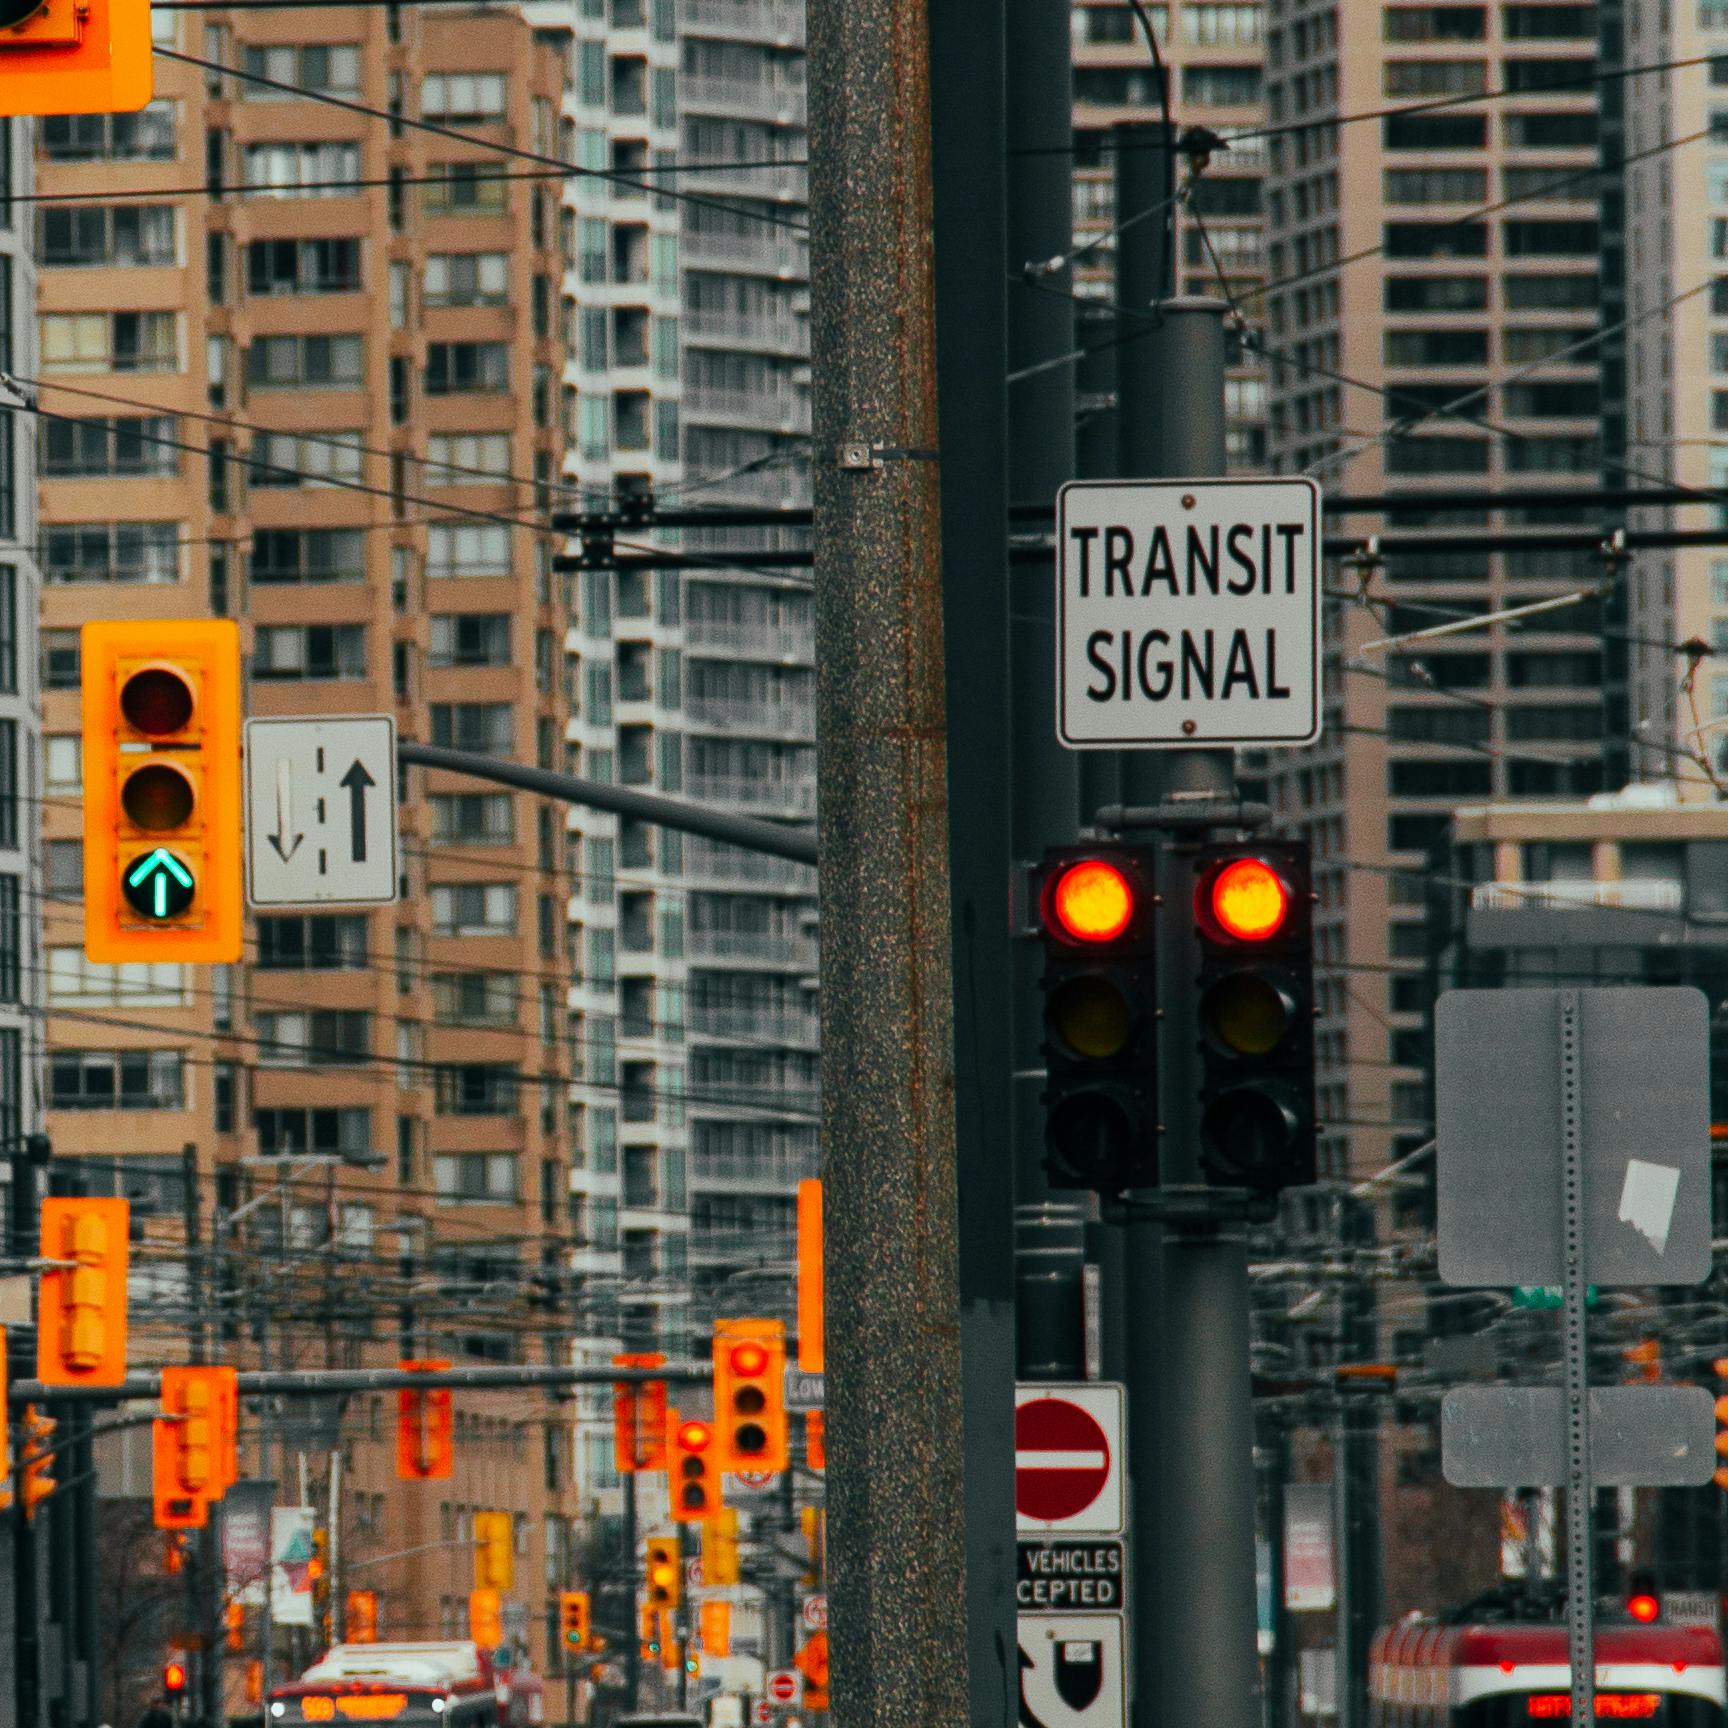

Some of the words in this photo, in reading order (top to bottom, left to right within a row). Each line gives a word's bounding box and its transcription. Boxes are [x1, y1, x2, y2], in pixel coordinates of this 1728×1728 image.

[1070, 523, 1305, 598] TRANSIT
[1085, 627, 1291, 703] SIGNAL
[1026, 1549, 1121, 1573] VEHICLES
[1016, 1579, 1114, 1603] CEPTED
